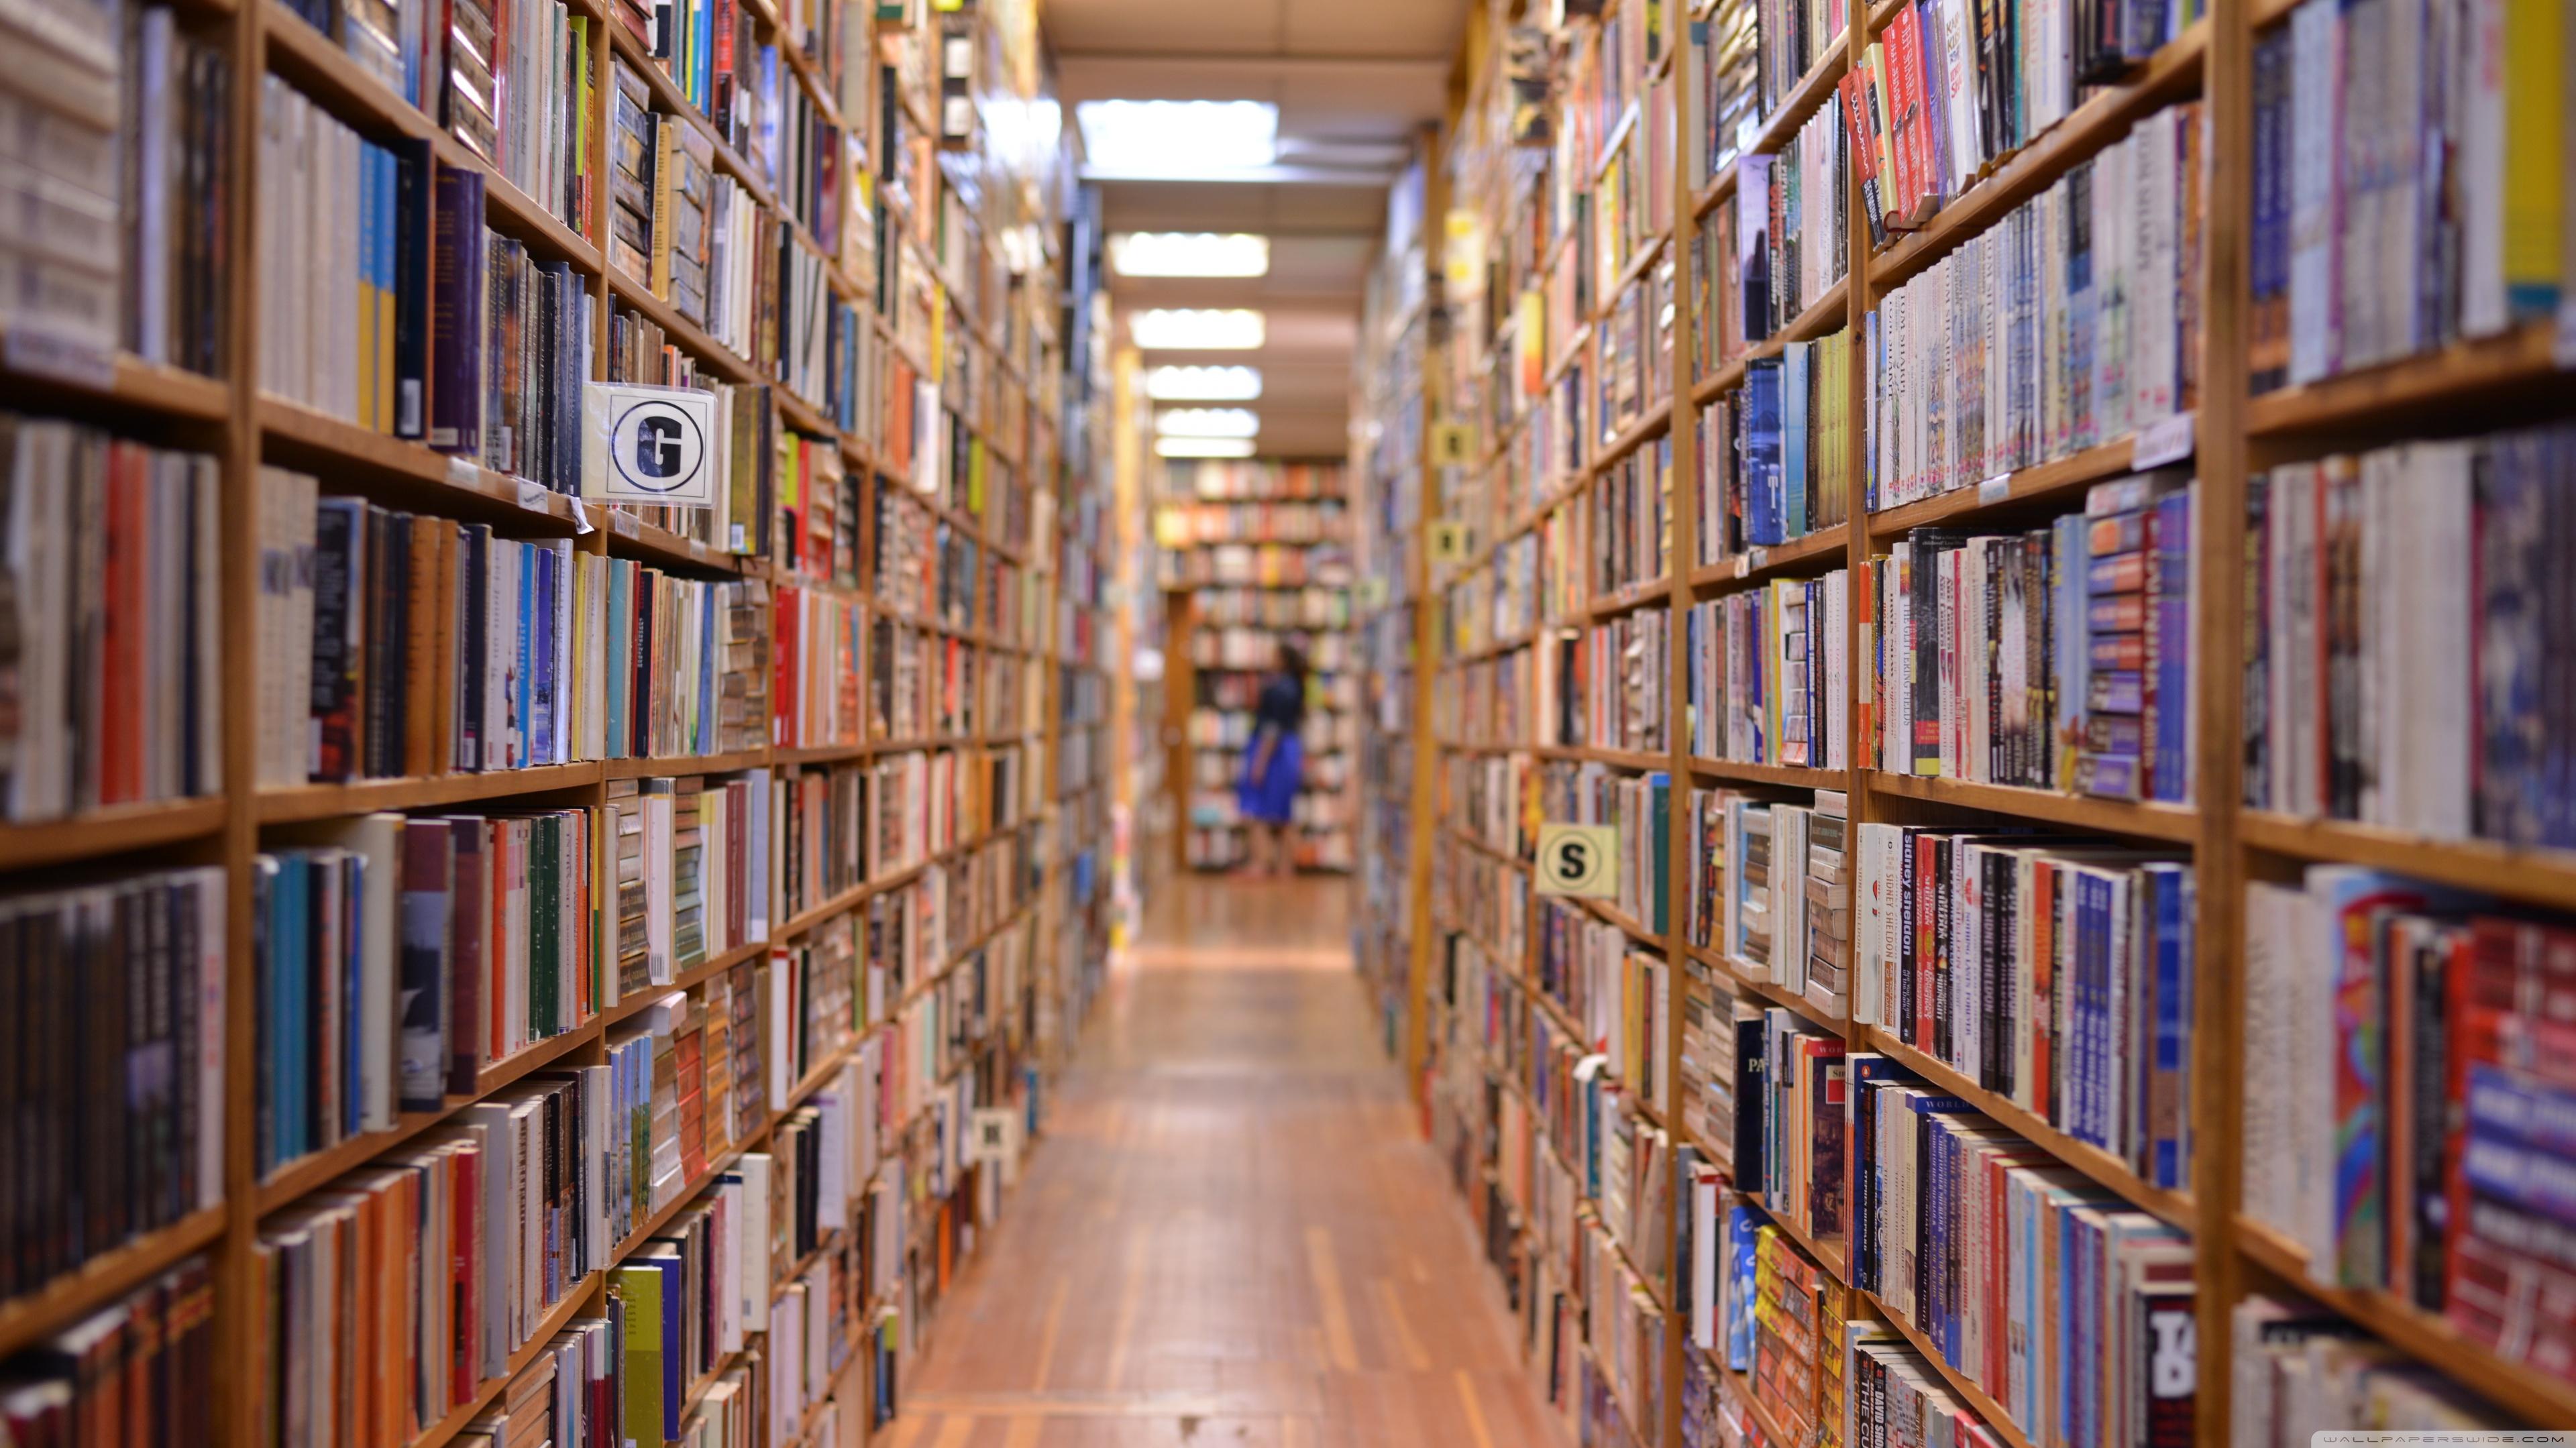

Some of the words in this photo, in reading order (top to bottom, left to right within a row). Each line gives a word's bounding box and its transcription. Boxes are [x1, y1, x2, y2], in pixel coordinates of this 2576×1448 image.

[1902, 25, 1912, 52] JEFF
[1903, 52, 1916, 101] SHAARA
[1864, 180, 1878, 224] SEYMOUR
[637, 416, 682, 478] G
[1559, 843, 1587, 879] S
[1902, 834, 1912, 887] sidney
[1903, 891, 1912, 956] sheldon
[1984, 912, 1994, 954] SIDNEY
[1984, 958, 1994, 1013] SHELDON
[1874, 1391, 1884, 1424] DAVID
